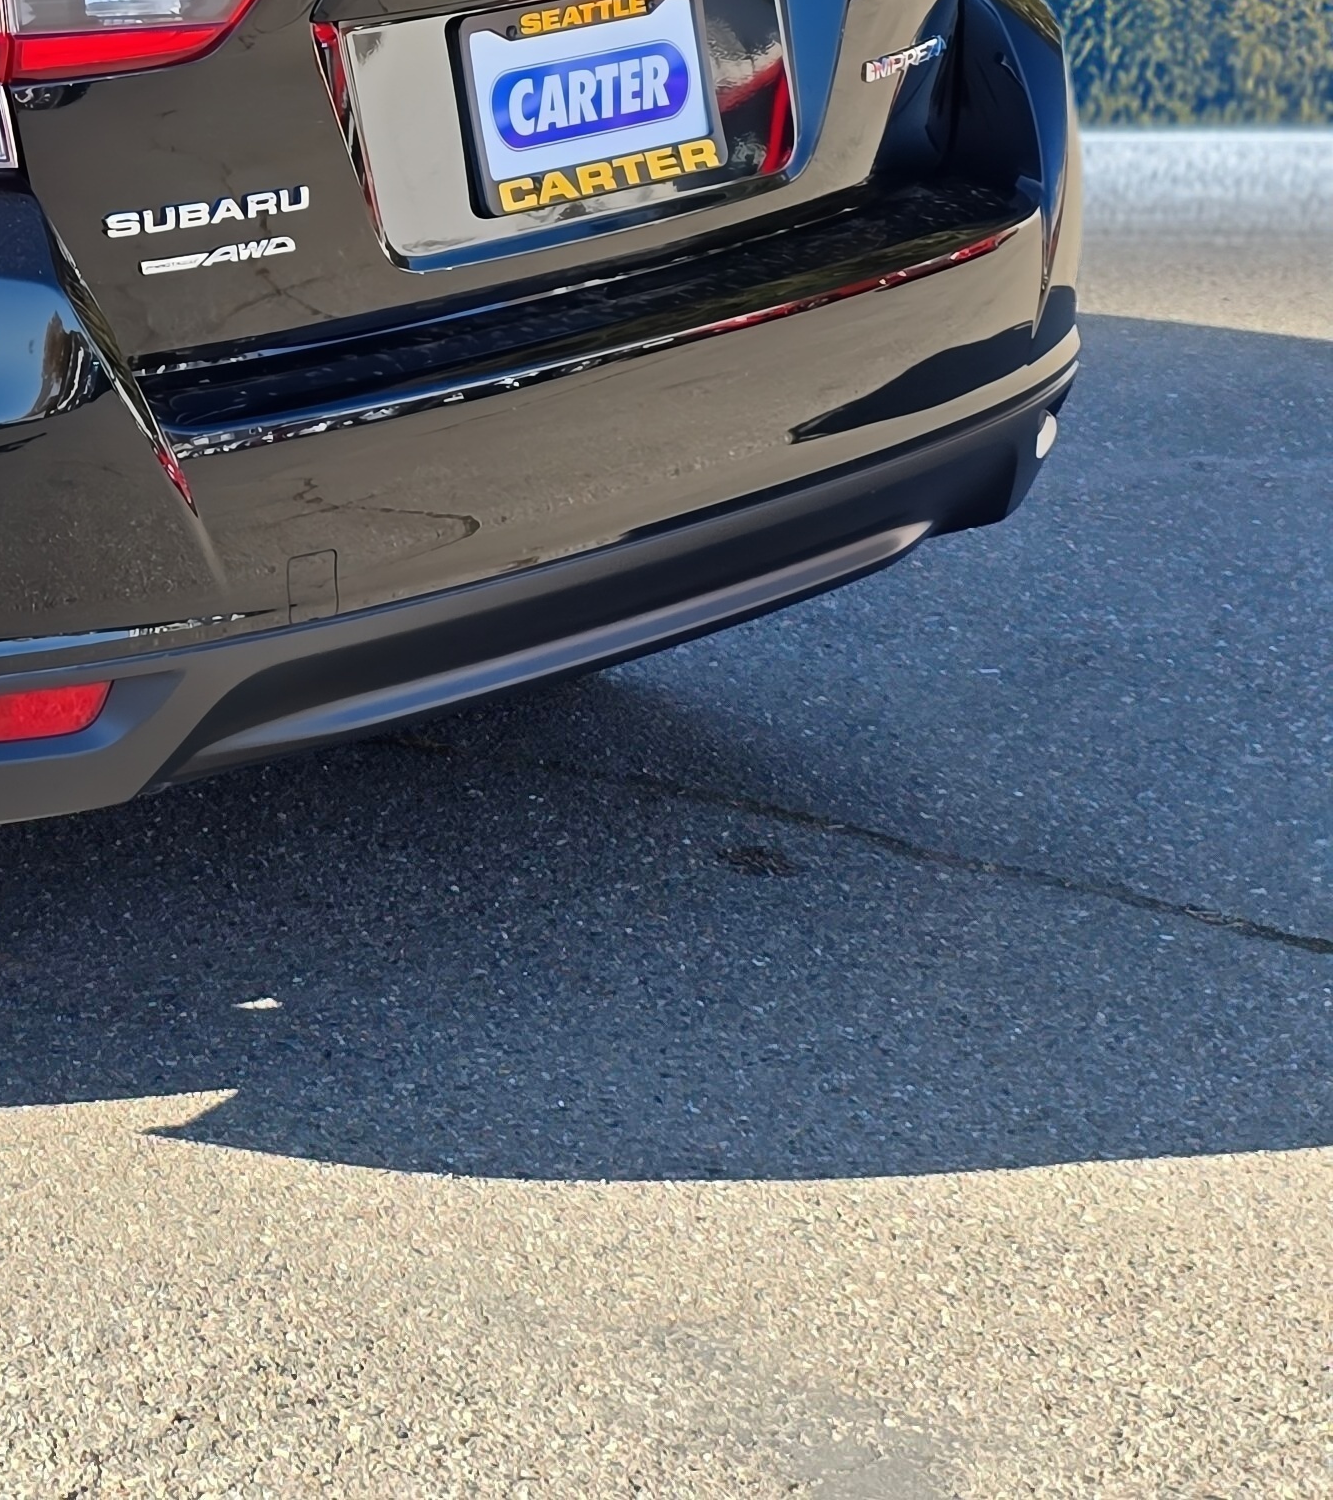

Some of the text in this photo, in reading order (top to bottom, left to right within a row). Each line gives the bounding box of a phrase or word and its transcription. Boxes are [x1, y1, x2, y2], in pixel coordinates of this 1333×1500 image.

[508, 54, 670, 136] CARTER
[498, 139, 720, 212] CARTER
[106, 185, 310, 238] SUBARU
[202, 236, 296, 266] AWD
